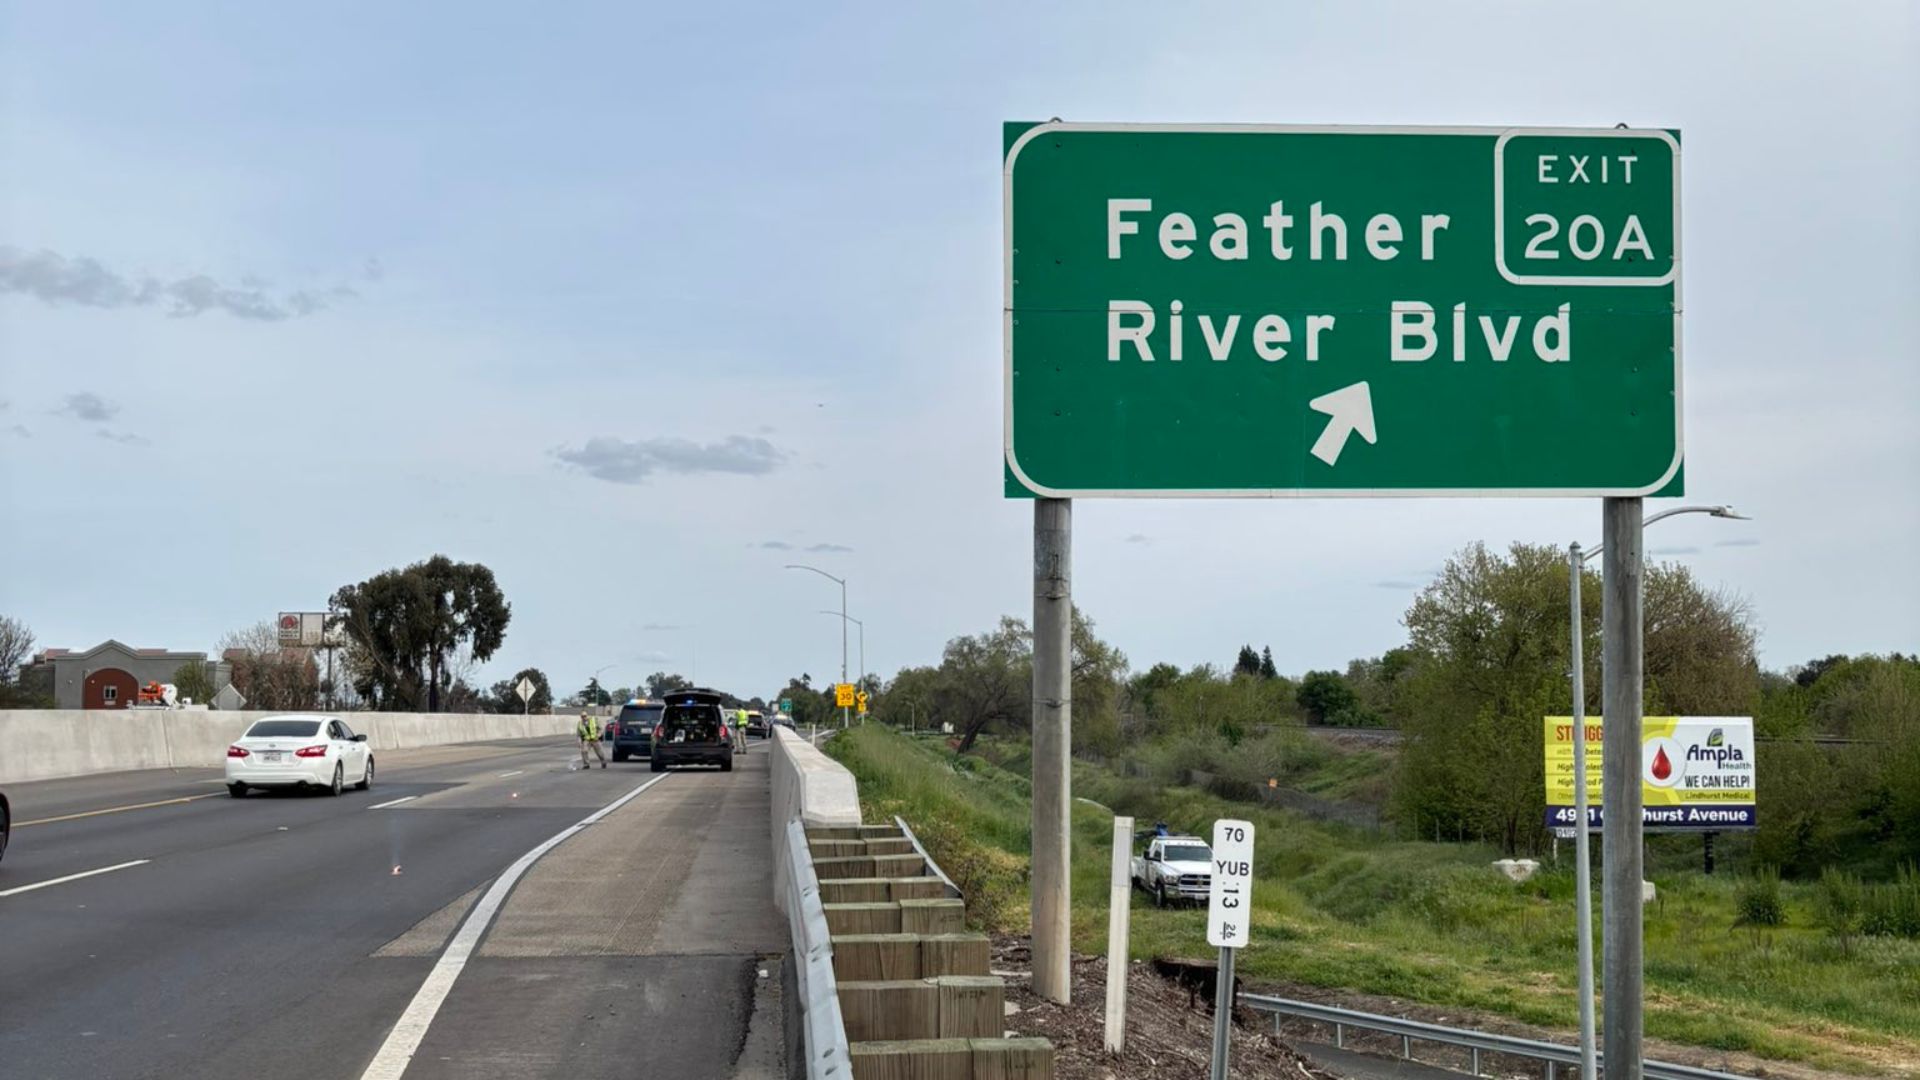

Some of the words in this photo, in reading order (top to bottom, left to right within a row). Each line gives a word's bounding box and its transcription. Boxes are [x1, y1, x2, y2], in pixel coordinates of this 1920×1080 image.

[1538, 155, 1638, 184] EXIT
[1108, 198, 1451, 261] Feather
[1524, 213, 1655, 261] 20A
[1108, 299, 1336, 362] River
[1390, 301, 1572, 363] Blvd
[1686, 743, 1744, 769] Ampla
[1722, 762, 1752, 770] Health
[1685, 775, 1700, 788] WE
[1701, 775, 1721, 788] CAN
[1723, 774, 1751, 788] HELP!
[1685, 792, 1721, 800] Lindhurst
[1723, 792, 1751, 800] Medical
[1556, 807, 1596, 822] 491
[1688, 807, 1749, 822] Avenue
[1224, 827, 1245, 842] 70
[1216, 859, 1250, 876] YUB
[1222, 888, 1239, 909] 13
